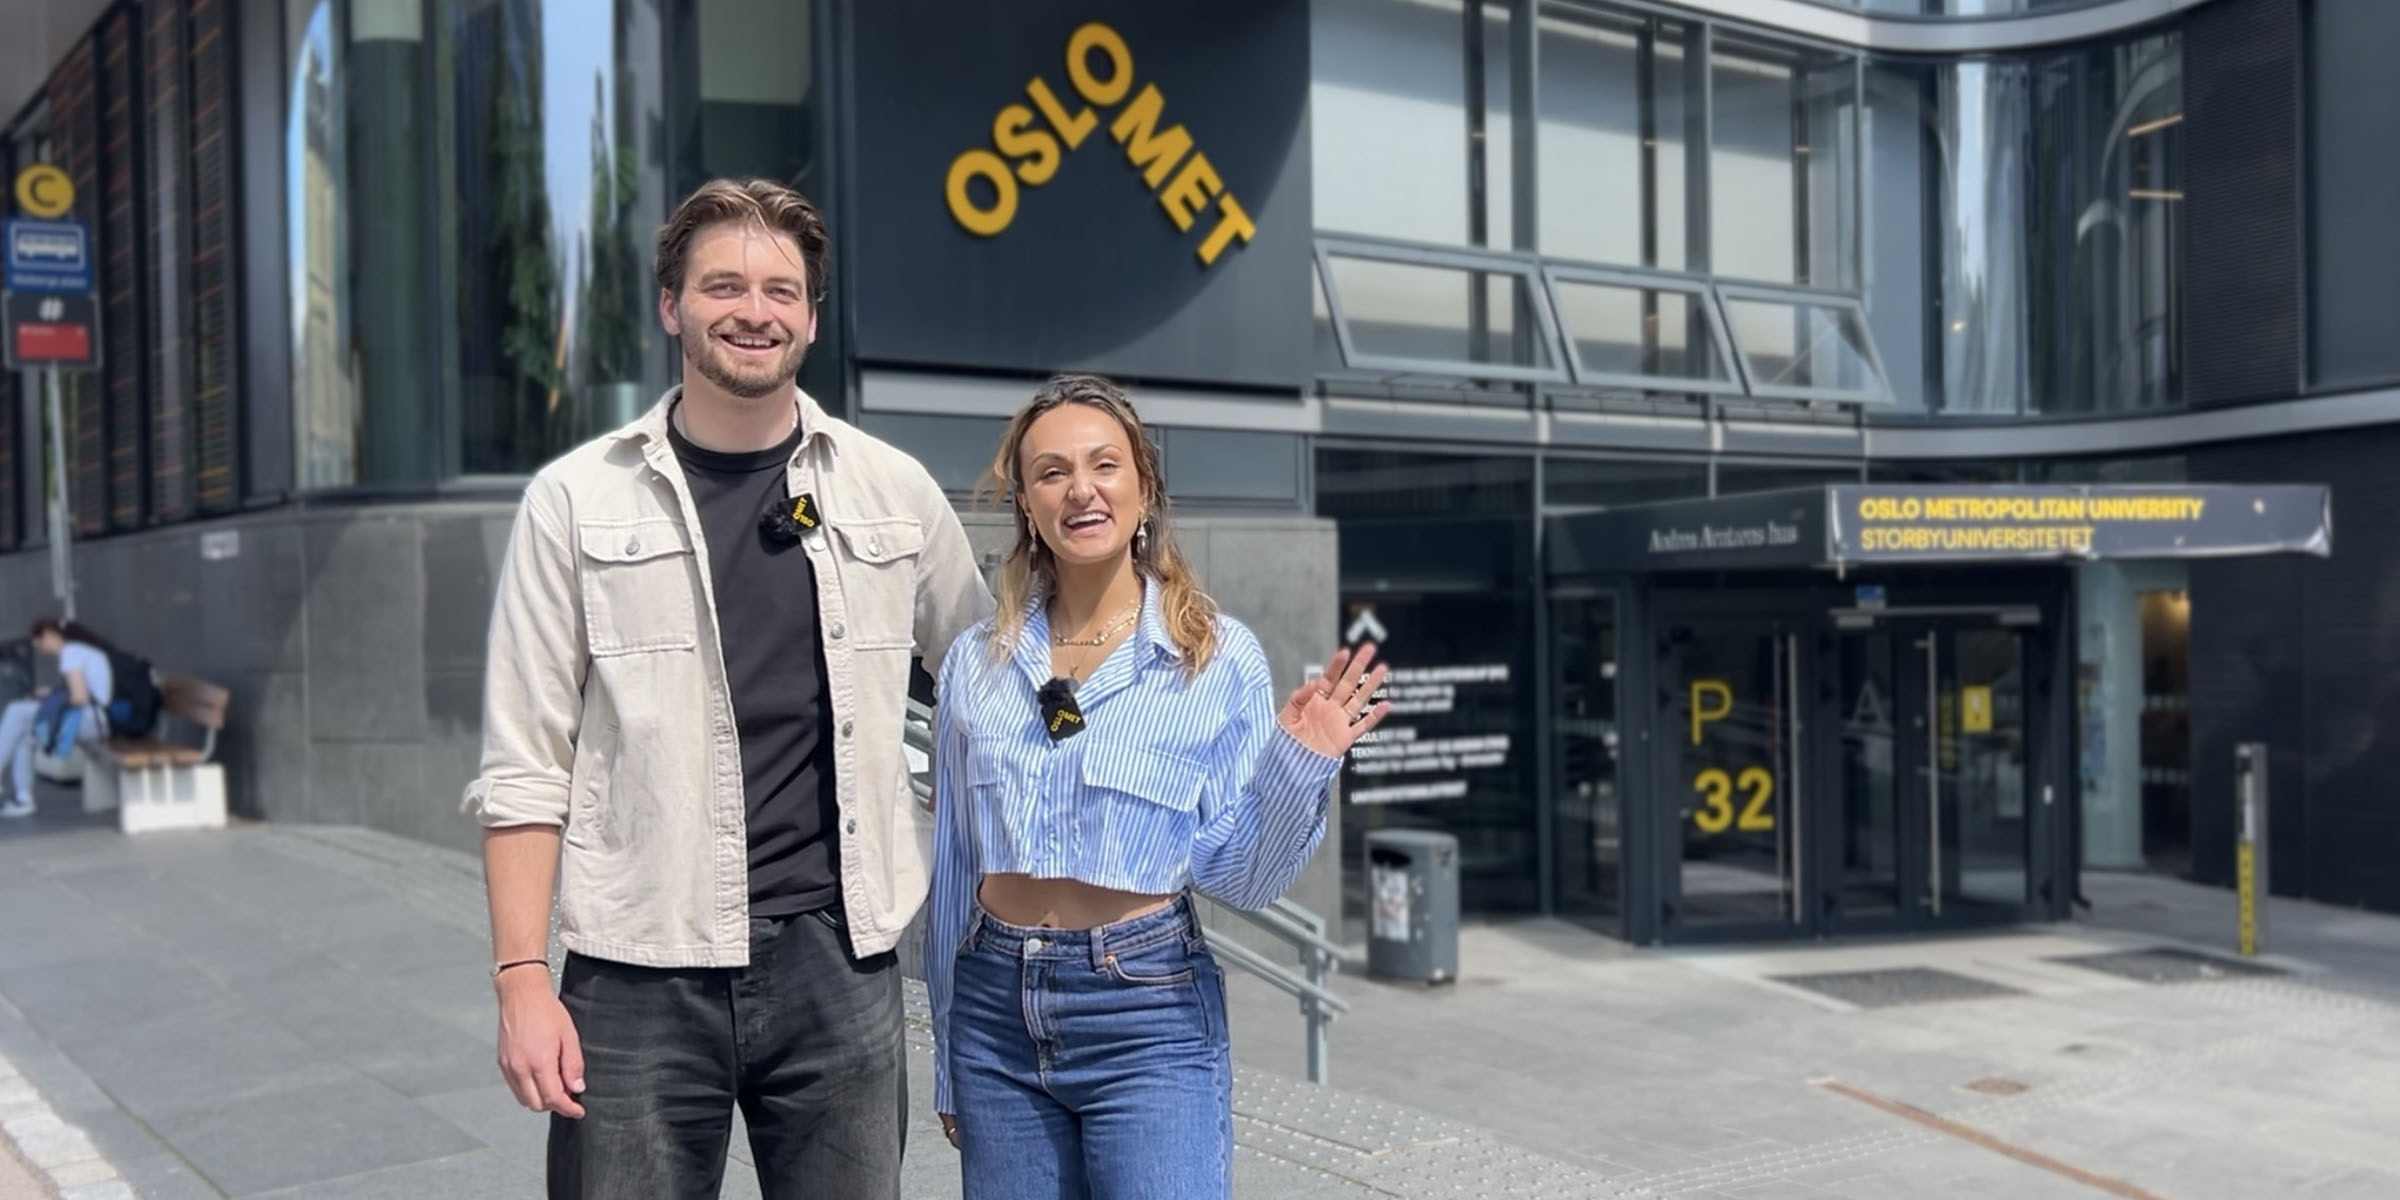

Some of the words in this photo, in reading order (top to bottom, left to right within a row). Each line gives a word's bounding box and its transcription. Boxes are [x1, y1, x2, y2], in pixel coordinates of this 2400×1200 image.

[945, 21, 1256, 267] OSLOMET
[29, 173, 57, 208] C
[1860, 498, 1919, 519] OSLO
[1925, 498, 2083, 520] METROPOLITAN
[2090, 497, 2204, 520] UNIVERSITY
[1861, 527, 2094, 551] STORBYUNIVERSITETET
[1050, 709, 1081, 732] OSLOMET
[1692, 680, 1733, 747] P
[1694, 766, 1775, 833] 32
